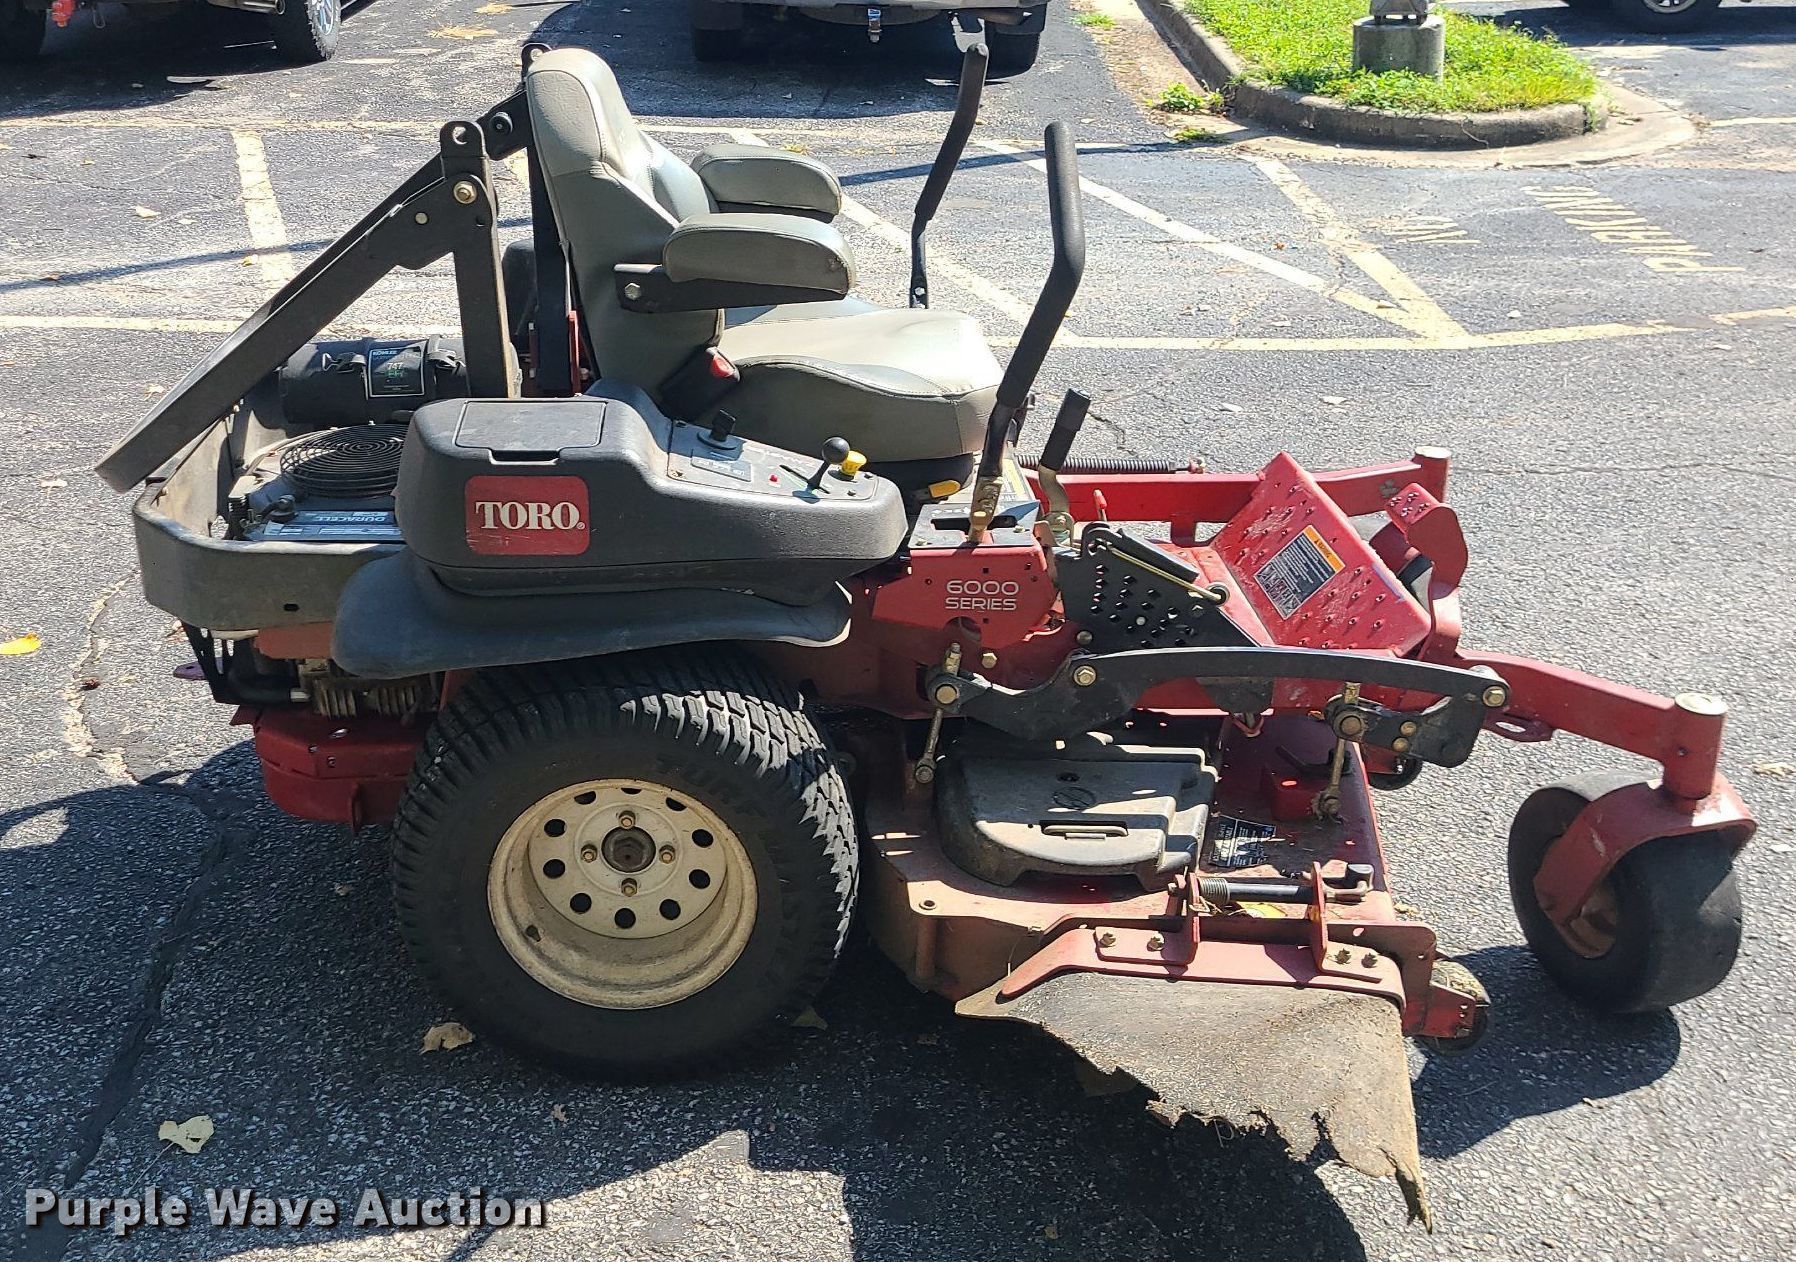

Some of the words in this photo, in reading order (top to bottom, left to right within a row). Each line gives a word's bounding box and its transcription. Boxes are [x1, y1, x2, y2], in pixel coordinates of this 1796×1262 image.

[1520, 185, 1746, 272] PARKING
[475, 501, 580, 530] TORO
[946, 580, 1019, 595] 6000
[945, 597, 1017, 611] SERIES
